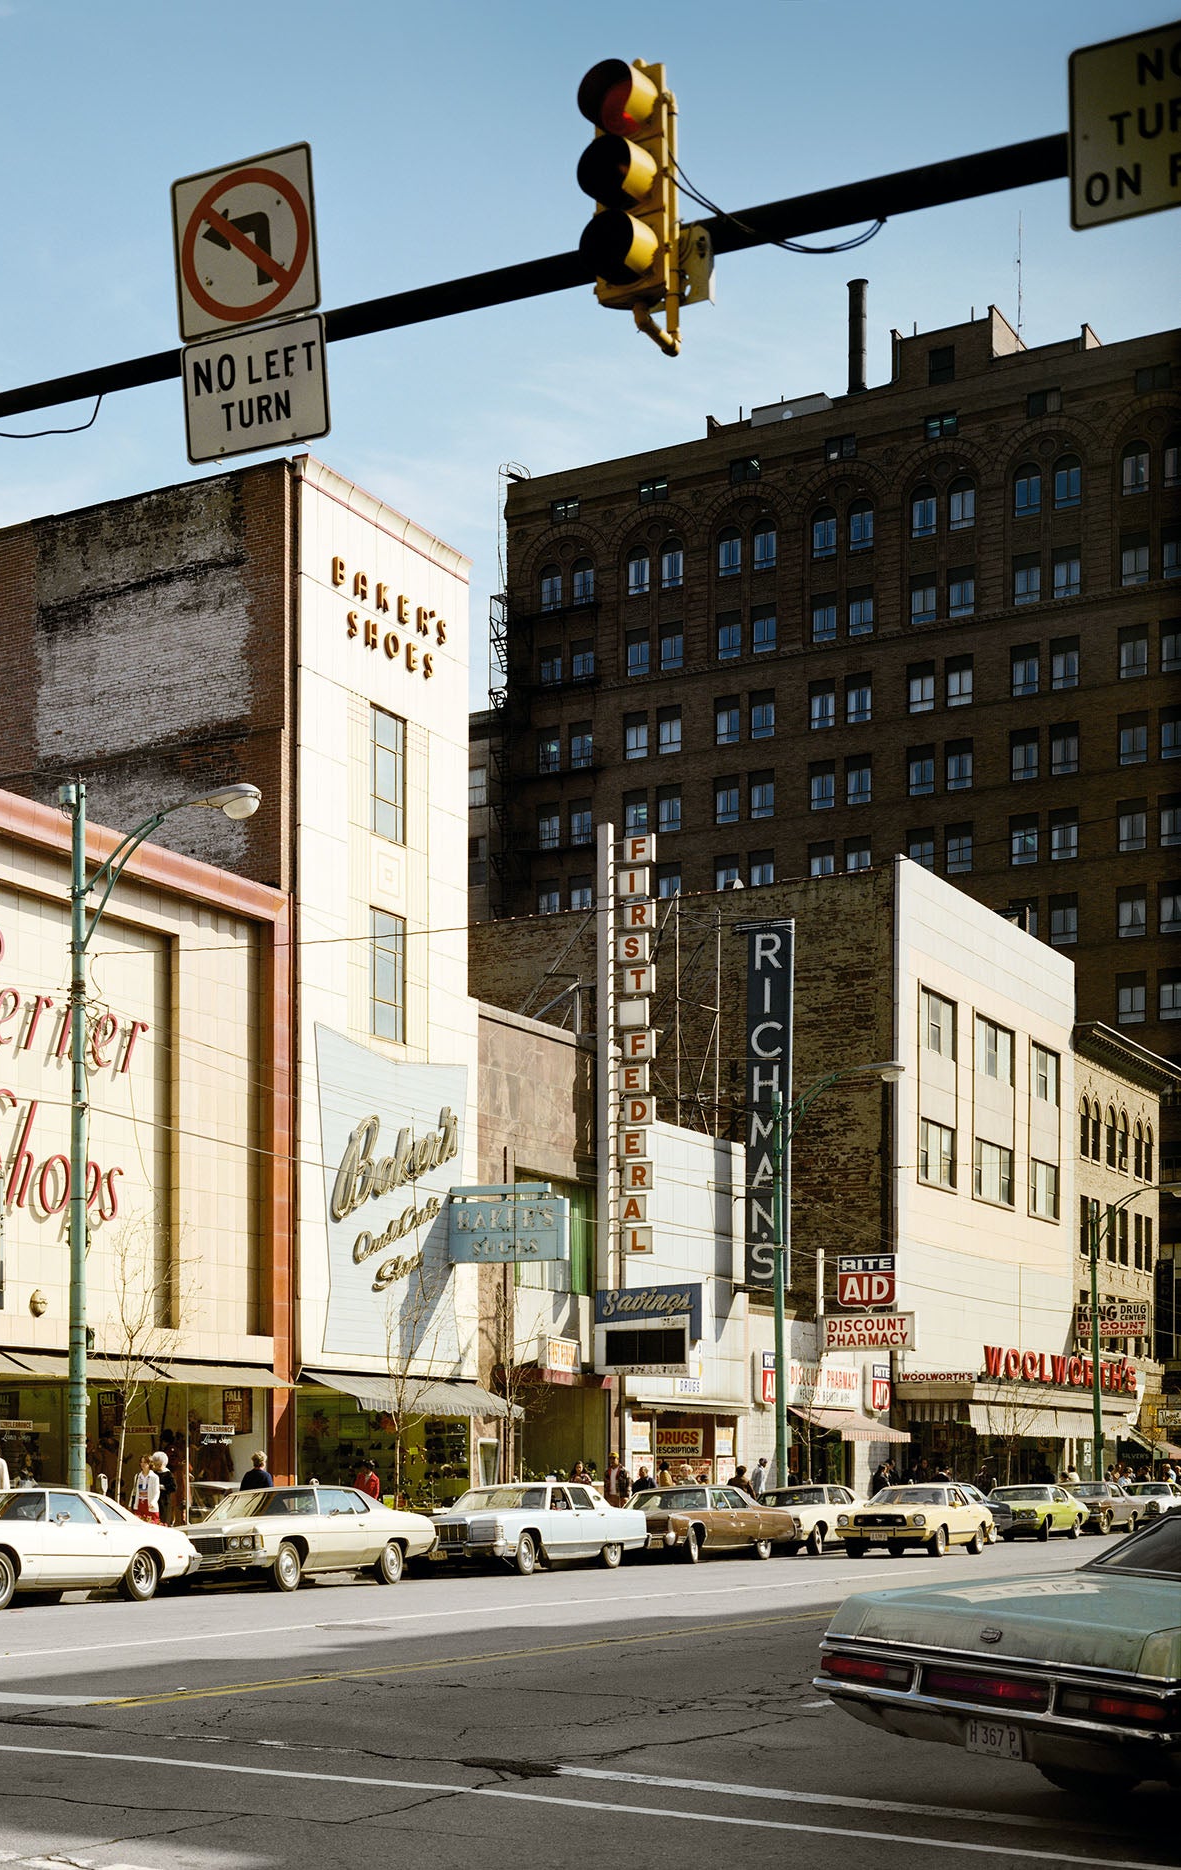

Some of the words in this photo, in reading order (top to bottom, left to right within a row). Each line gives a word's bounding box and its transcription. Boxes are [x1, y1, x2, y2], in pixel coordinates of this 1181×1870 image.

[1108, 97, 1181, 145] TU
[1084, 163, 1141, 207] ON
[193, 353, 236, 396] NO
[248, 341, 316, 385] LEFT
[221, 389, 291, 432] TURN
[332, 556, 447, 645] BAKER'S
[347, 611, 434, 679] SHOES
[624, 838, 646, 990] FIRST
[623, 1033, 647, 1252] FEDERAL
[457, 1206, 554, 1231] BAKER'S
[472, 1237, 539, 1257] SHOES
[842, 1258, 892, 1271] RITE
[843, 1276, 890, 1301] AID
[602, 1288, 694, 1317] Savings
[1120, 1304, 1147, 1314] DRUG
[828, 1317, 907, 1333] DISCOUNT
[1078, 1322, 1147, 1330] DICOUNT
[827, 1332, 909, 1347] PHARMACY
[764, 1354, 776, 1367] RI
[873, 1365, 890, 1378] RITE
[983, 1344, 1138, 1392] WOOLWORTH'S
[765, 1373, 776, 1400] AI
[826, 1370, 859, 1391] PHARMACY
[902, 1372, 973, 1382] WOOLWORTH'S
[224, 1390, 243, 1401] FALL
[874, 1382, 890, 1409] AID
[656, 1431, 699, 1445] DRUGS
[656, 1446, 699, 1454] RESCRIPTIONS
[981, 1726, 1004, 1747] 367
[1009, 1731, 1016, 1749] P
